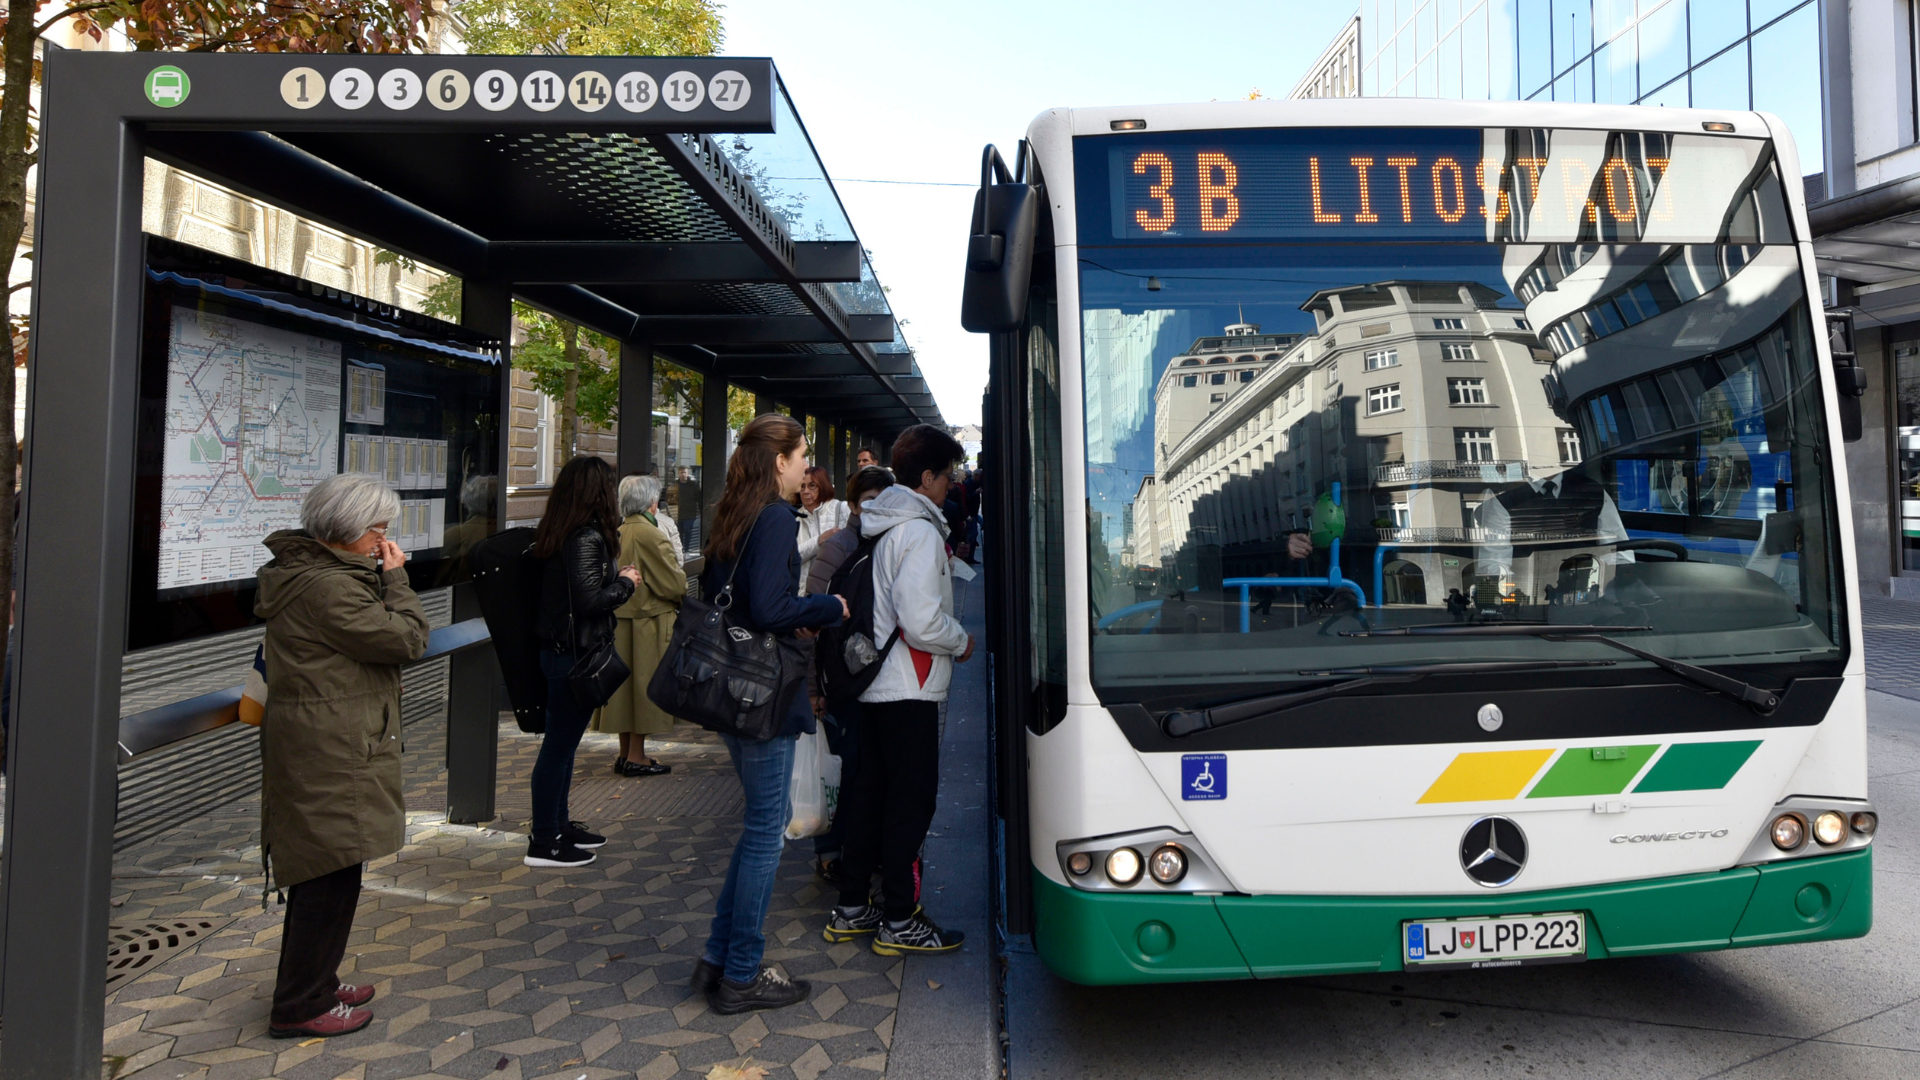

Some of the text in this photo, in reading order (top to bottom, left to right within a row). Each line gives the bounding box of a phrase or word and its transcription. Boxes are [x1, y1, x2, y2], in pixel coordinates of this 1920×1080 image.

[295, 73, 309, 102] 1
[344, 76, 359, 100] 2
[393, 77, 408, 101] 3
[439, 74, 457, 103] 6
[488, 76, 505, 103] 9
[529, 76, 556, 103] 11
[575, 77, 607, 105] 14
[623, 80, 650, 103] 18
[670, 79, 698, 102] 19
[715, 79, 745, 102] 27
[1310, 157, 1671, 223] LITOSTROJ
[1609, 829, 1729, 844] CONECTO
[1409, 947, 1423, 957] SLO
[1424, 926, 1457, 956] LJ
